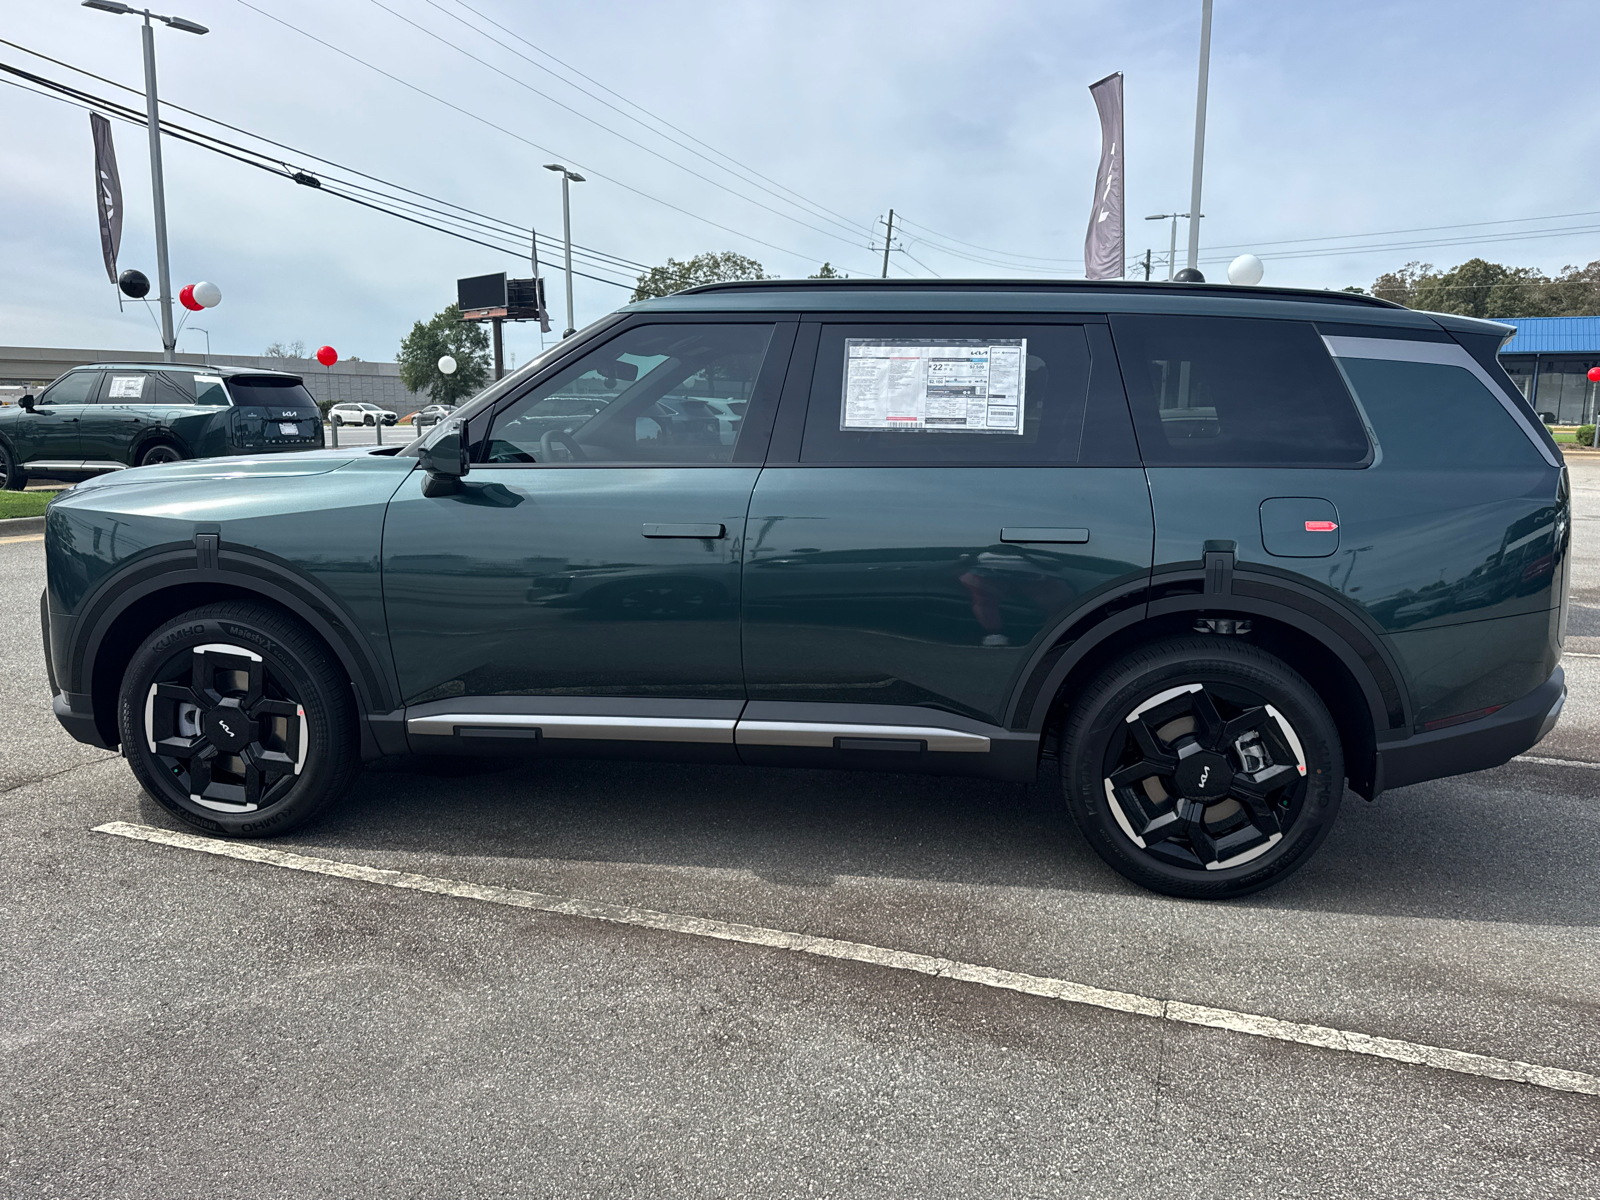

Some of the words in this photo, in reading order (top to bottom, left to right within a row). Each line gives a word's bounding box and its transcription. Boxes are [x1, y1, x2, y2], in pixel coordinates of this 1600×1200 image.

[152, 624, 205, 654] KUMHO
[218, 720, 235, 738] KIA
[1198, 765, 1211, 788] KIA
[240, 805, 296, 834] KUMHO
